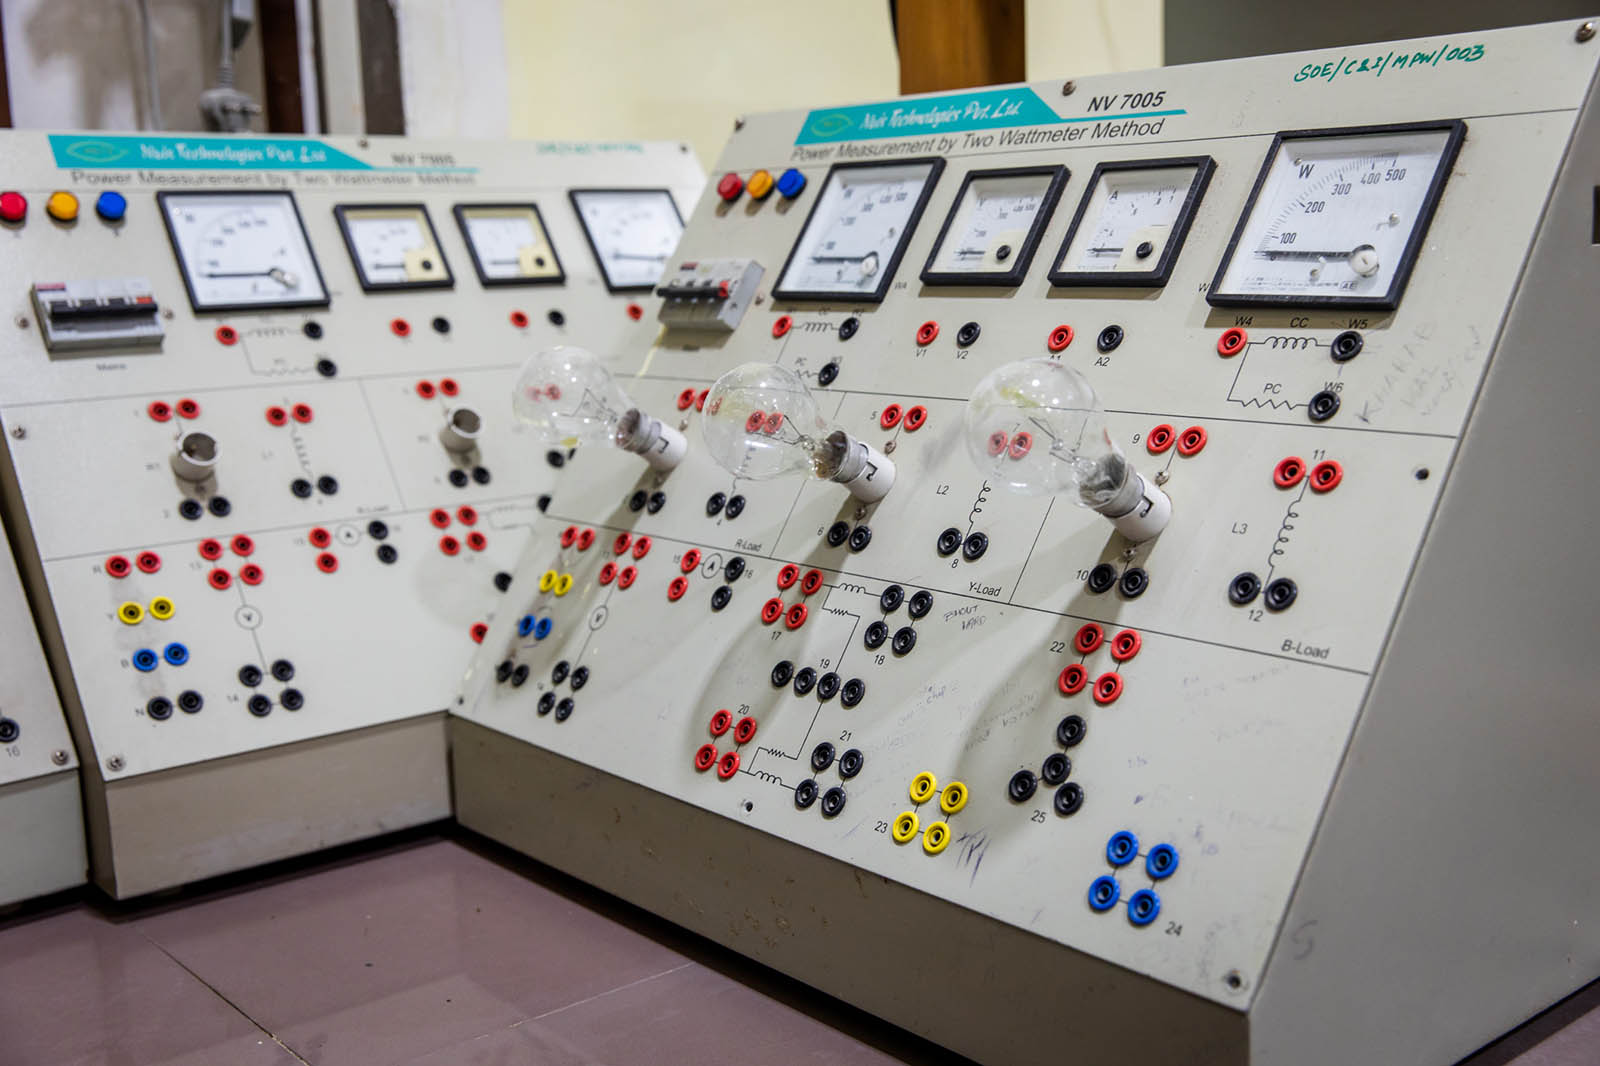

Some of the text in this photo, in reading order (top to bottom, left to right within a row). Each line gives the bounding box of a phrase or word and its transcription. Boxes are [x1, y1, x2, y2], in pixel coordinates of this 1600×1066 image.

[1087, 91, 1167, 112] NV 7005
[790, 118, 1166, 161] Power Measurement by Two Wattmeter Method
[1298, 164, 1316, 179] W
[1384, 168, 1408, 182] 500
[1360, 172, 1382, 185] 400
[1331, 183, 1353, 196] 300
[1109, 191, 1119, 200] A
[1304, 200, 1326, 214] 200
[1280, 232, 1297, 244] 100
[1234, 316, 1253, 327] W4
[1290, 317, 1309, 328] CC
[1348, 319, 1369, 330] W5
[956, 350, 969, 360] V2
[1095, 357, 1110, 367] A2
[1263, 383, 1282, 394] PC
[1324, 382, 1345, 392] W6
[1132, 434, 1140, 444] 9
[1312, 449, 1326, 460] 11
[936, 485, 949, 495] L2
[1232, 522, 1248, 534] L3
[707, 561, 716, 571] A
[951, 559, 959, 568] 8
[1075, 569, 1089, 581] 10
[969, 581, 1002, 597] Y-Load
[1248, 609, 1263, 623] 12
[770, 630, 782, 641] 17
[1050, 640, 1065, 653] 22
[1281, 639, 1330, 659] B-Load
[819, 658, 831, 669] 19
[873, 655, 885, 666] 18
[737, 704, 750, 715] 20
[839, 730, 853, 741] 21
[1031, 809, 1047, 824] 25
[874, 821, 888, 834] 23
[1165, 921, 1183, 937] 24
